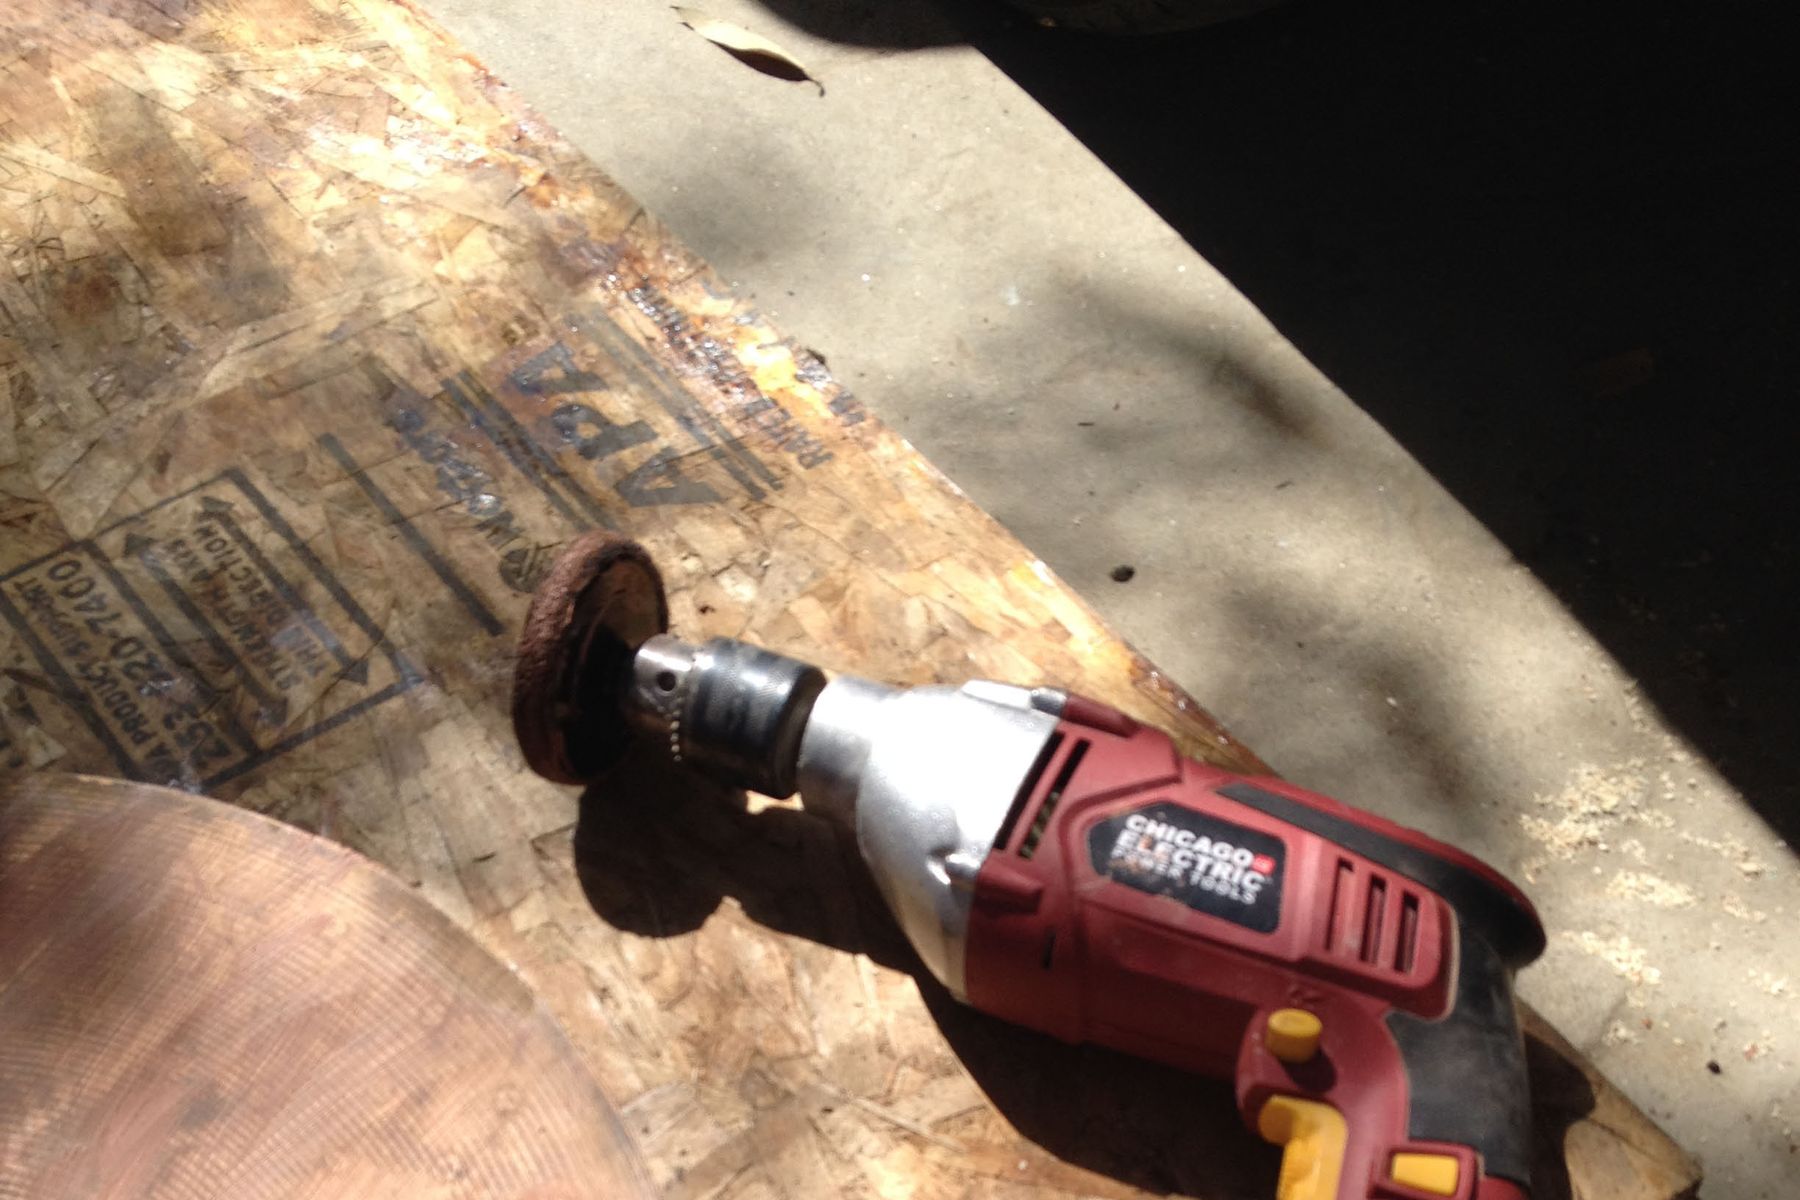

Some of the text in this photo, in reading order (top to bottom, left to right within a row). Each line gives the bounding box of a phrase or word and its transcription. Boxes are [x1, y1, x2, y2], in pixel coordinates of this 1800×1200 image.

[509, 341, 729, 507] APA
[165, 539, 214, 583] AXIS
[194, 522, 329, 677] THI DIRECTION
[75, 656, 157, 745] PRODUCT
[1116, 829, 1265, 892] ELECTRIC
[1126, 814, 1255, 868] CHICAGO
[1188, 868, 1258, 905] TOOLS
